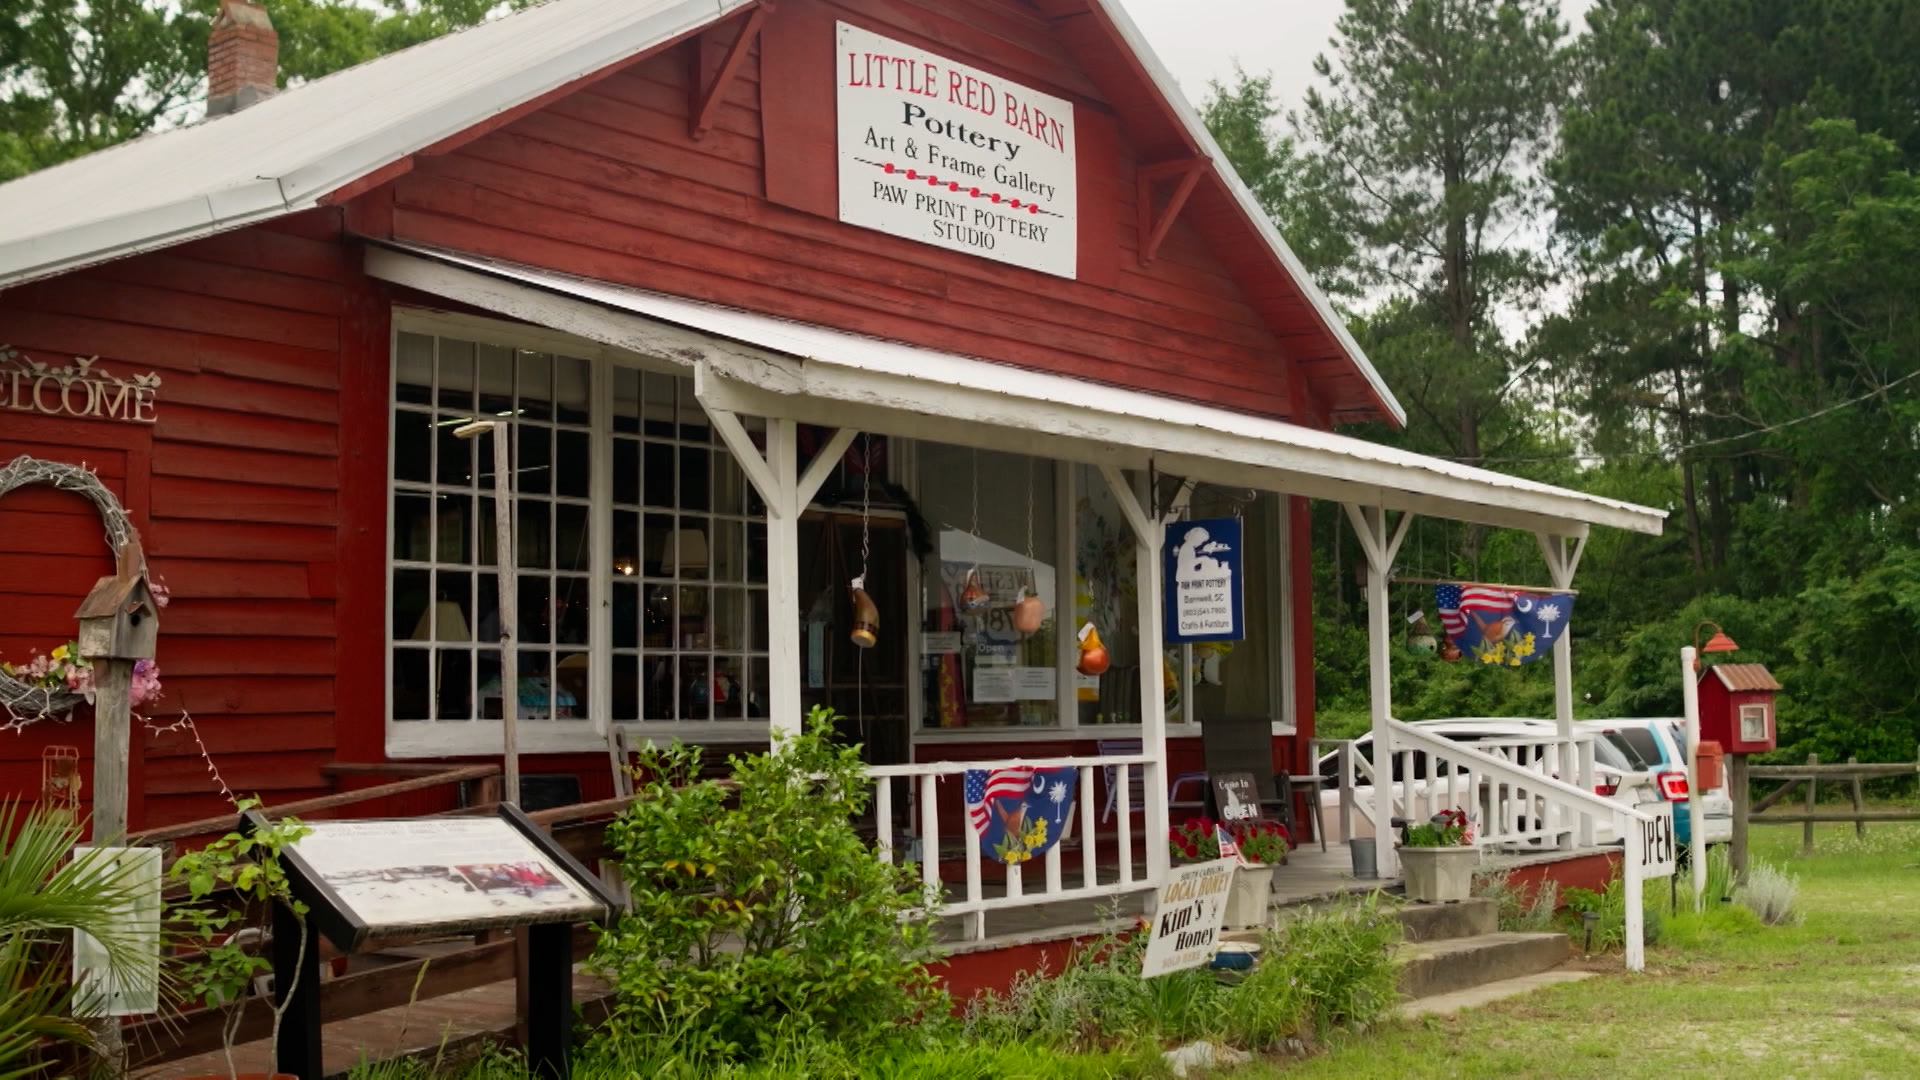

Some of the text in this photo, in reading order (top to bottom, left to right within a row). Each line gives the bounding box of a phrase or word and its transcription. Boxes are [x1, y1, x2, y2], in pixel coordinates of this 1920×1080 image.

[848, 53, 1064, 154] LITTLE RED BARN
[901, 101, 1021, 161] Pottery
[864, 125, 1056, 201] Art & Frame Gallery
[873, 181, 1049, 244] PAW PRINT POTTERY
[933, 219, 995, 250] STUDIO
[1205, 578, 1226, 588] POTTERY
[1181, 621, 1198, 630] Crafts
[1204, 620, 1229, 629] Furniture
[978, 643, 1005, 653] Open
[1240, 779, 1249, 788] In
[1199, 866, 1224, 878] CAROLINA
[1163, 872, 1231, 904] LOCAL HONEY
[1159, 899, 1204, 939] Kim's
[1175, 927, 1216, 952] Honey
